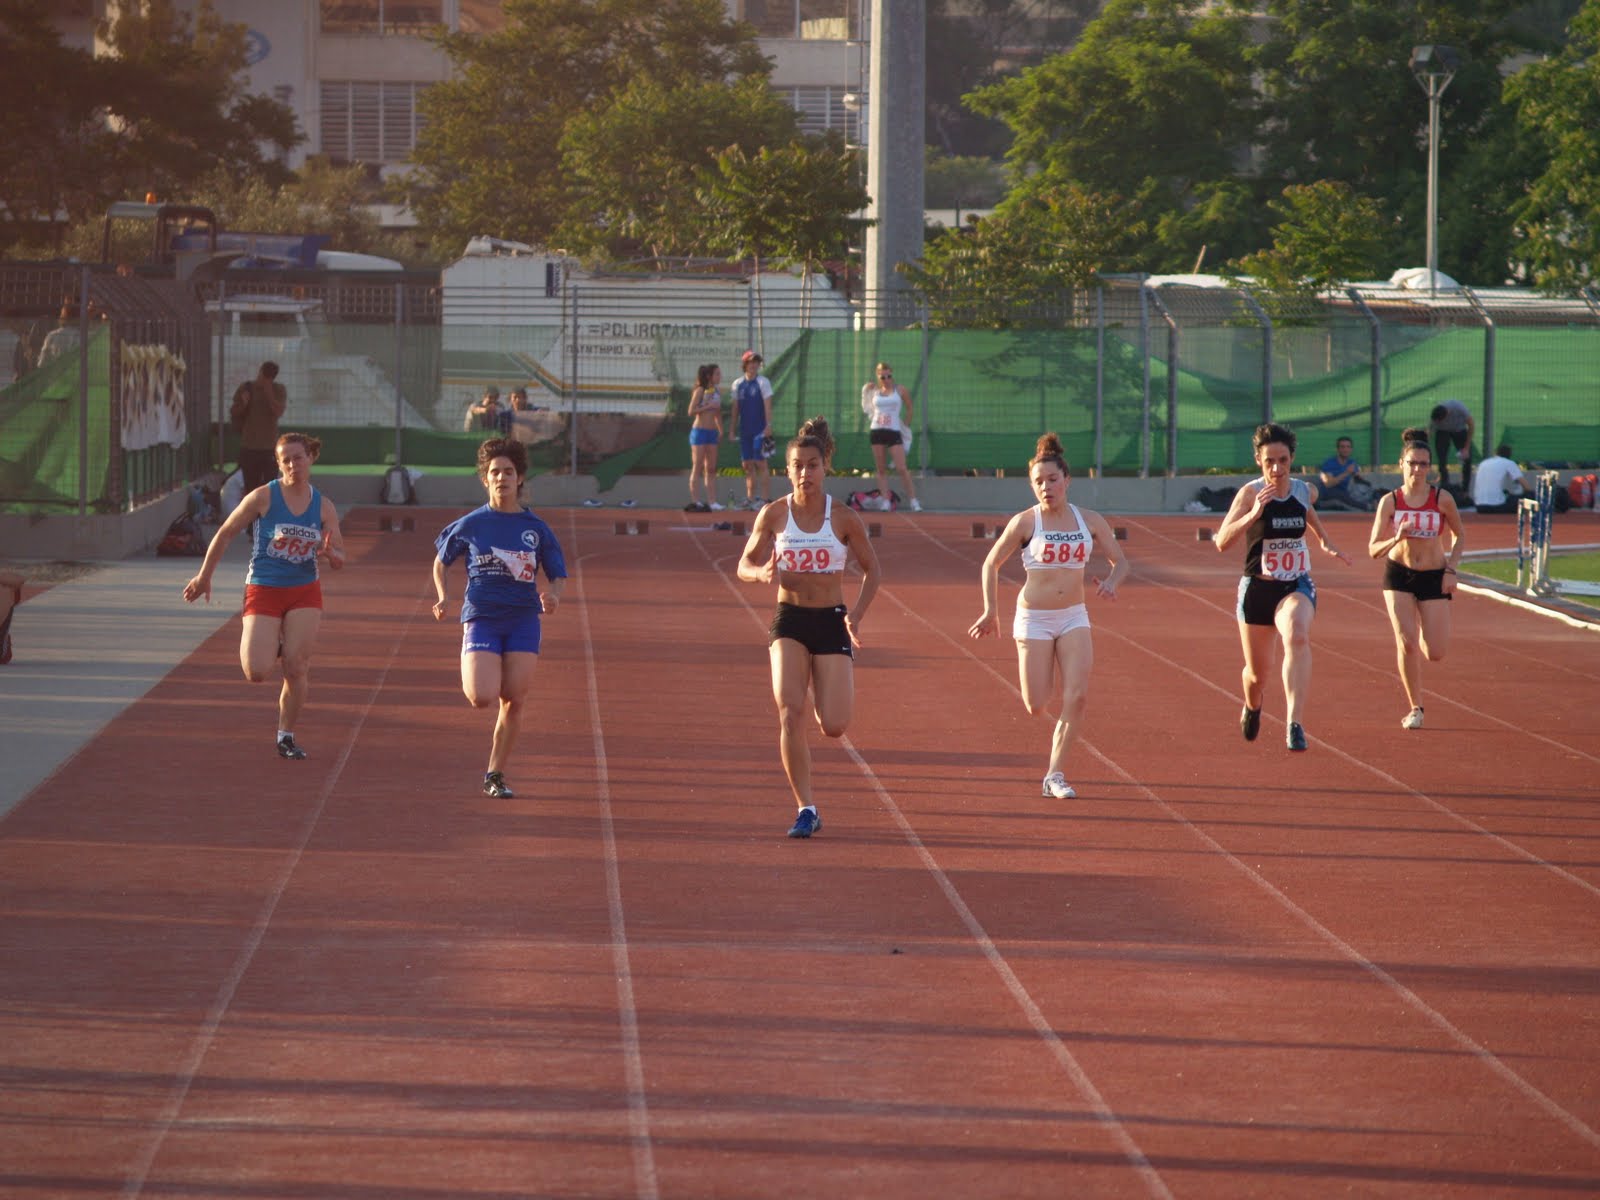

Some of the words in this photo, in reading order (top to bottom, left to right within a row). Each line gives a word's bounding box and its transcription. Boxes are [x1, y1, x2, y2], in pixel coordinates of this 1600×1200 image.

[281, 526, 316, 539] adidas
[1045, 532, 1084, 542] adidas
[1043, 543, 1086, 563] 584
[1269, 540, 1303, 550] adidas
[783, 548, 830, 571] 329
[1266, 551, 1306, 572] 501
